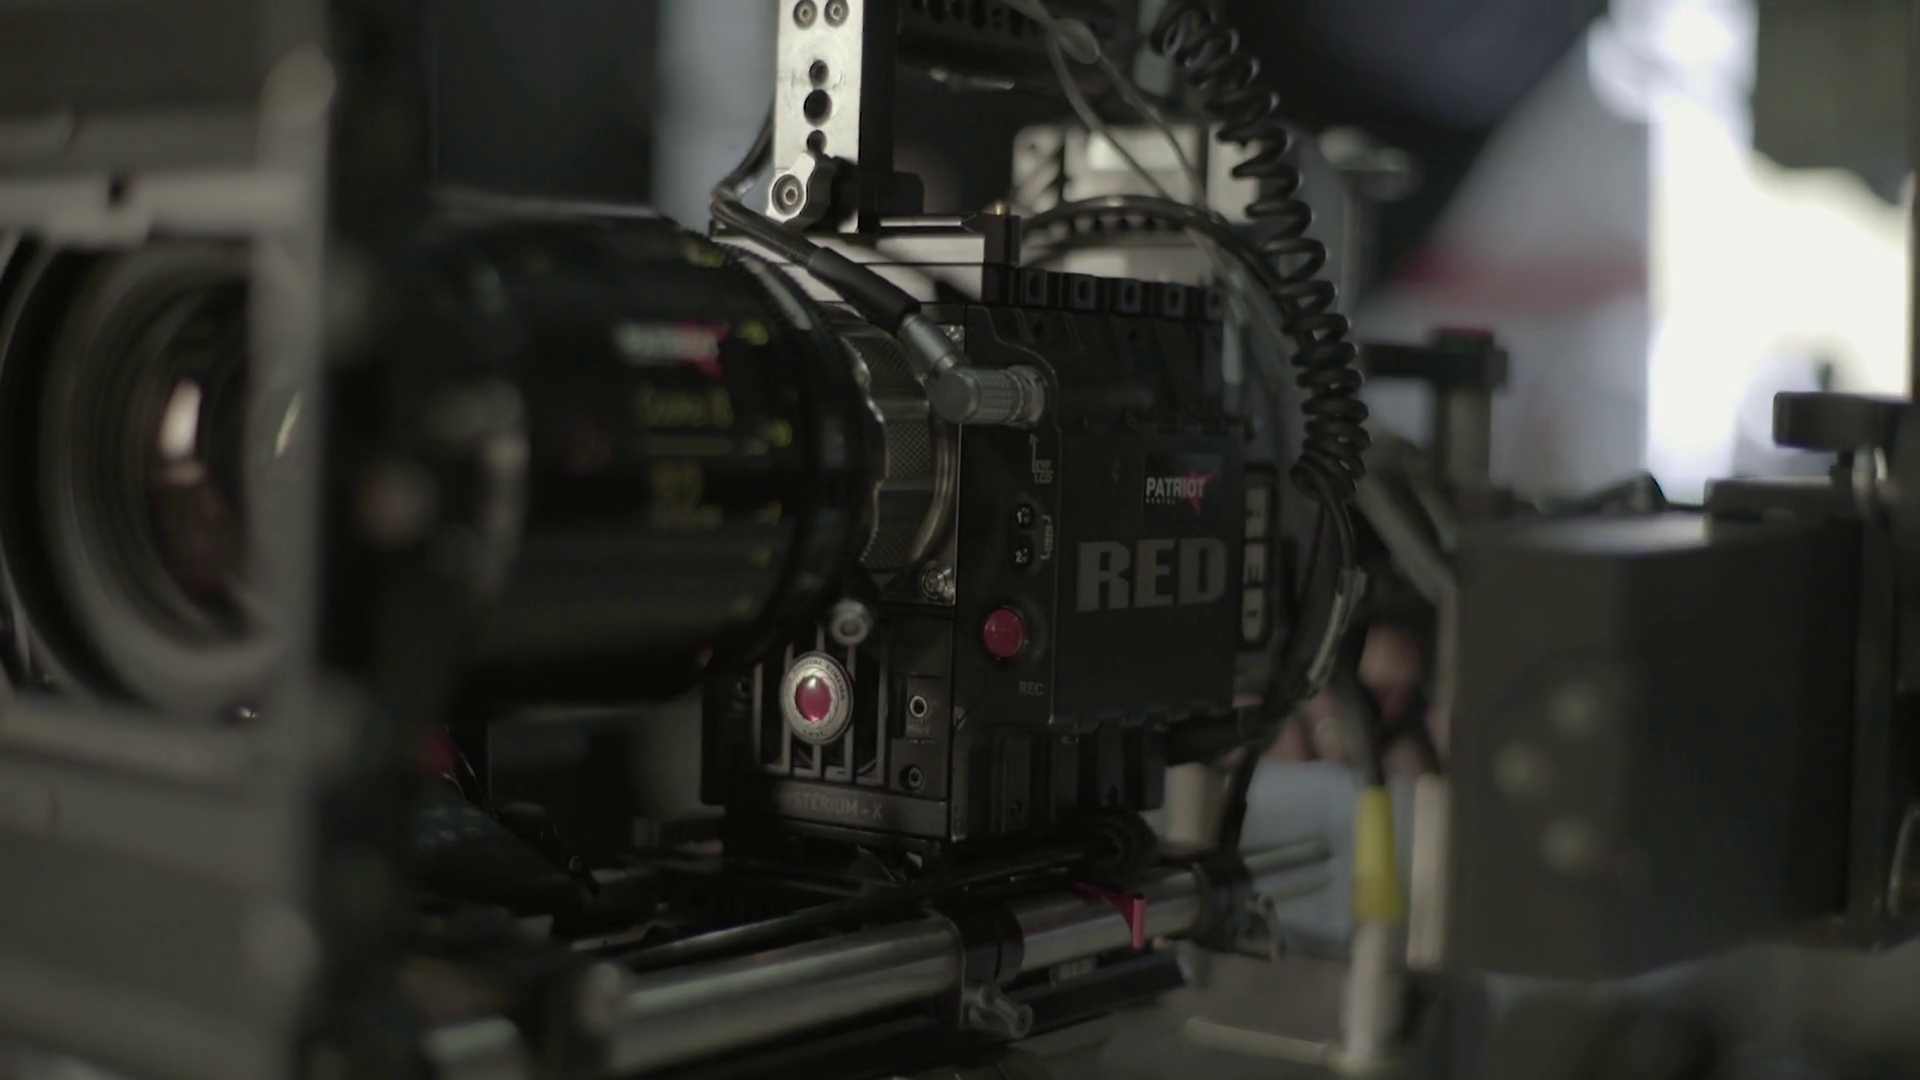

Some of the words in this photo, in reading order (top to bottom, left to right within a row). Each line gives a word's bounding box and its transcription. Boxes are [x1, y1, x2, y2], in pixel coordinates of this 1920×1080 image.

[1146, 477, 1205, 498] PATRIOT
[1076, 537, 1226, 611] RED
[1018, 681, 1045, 697] REC
